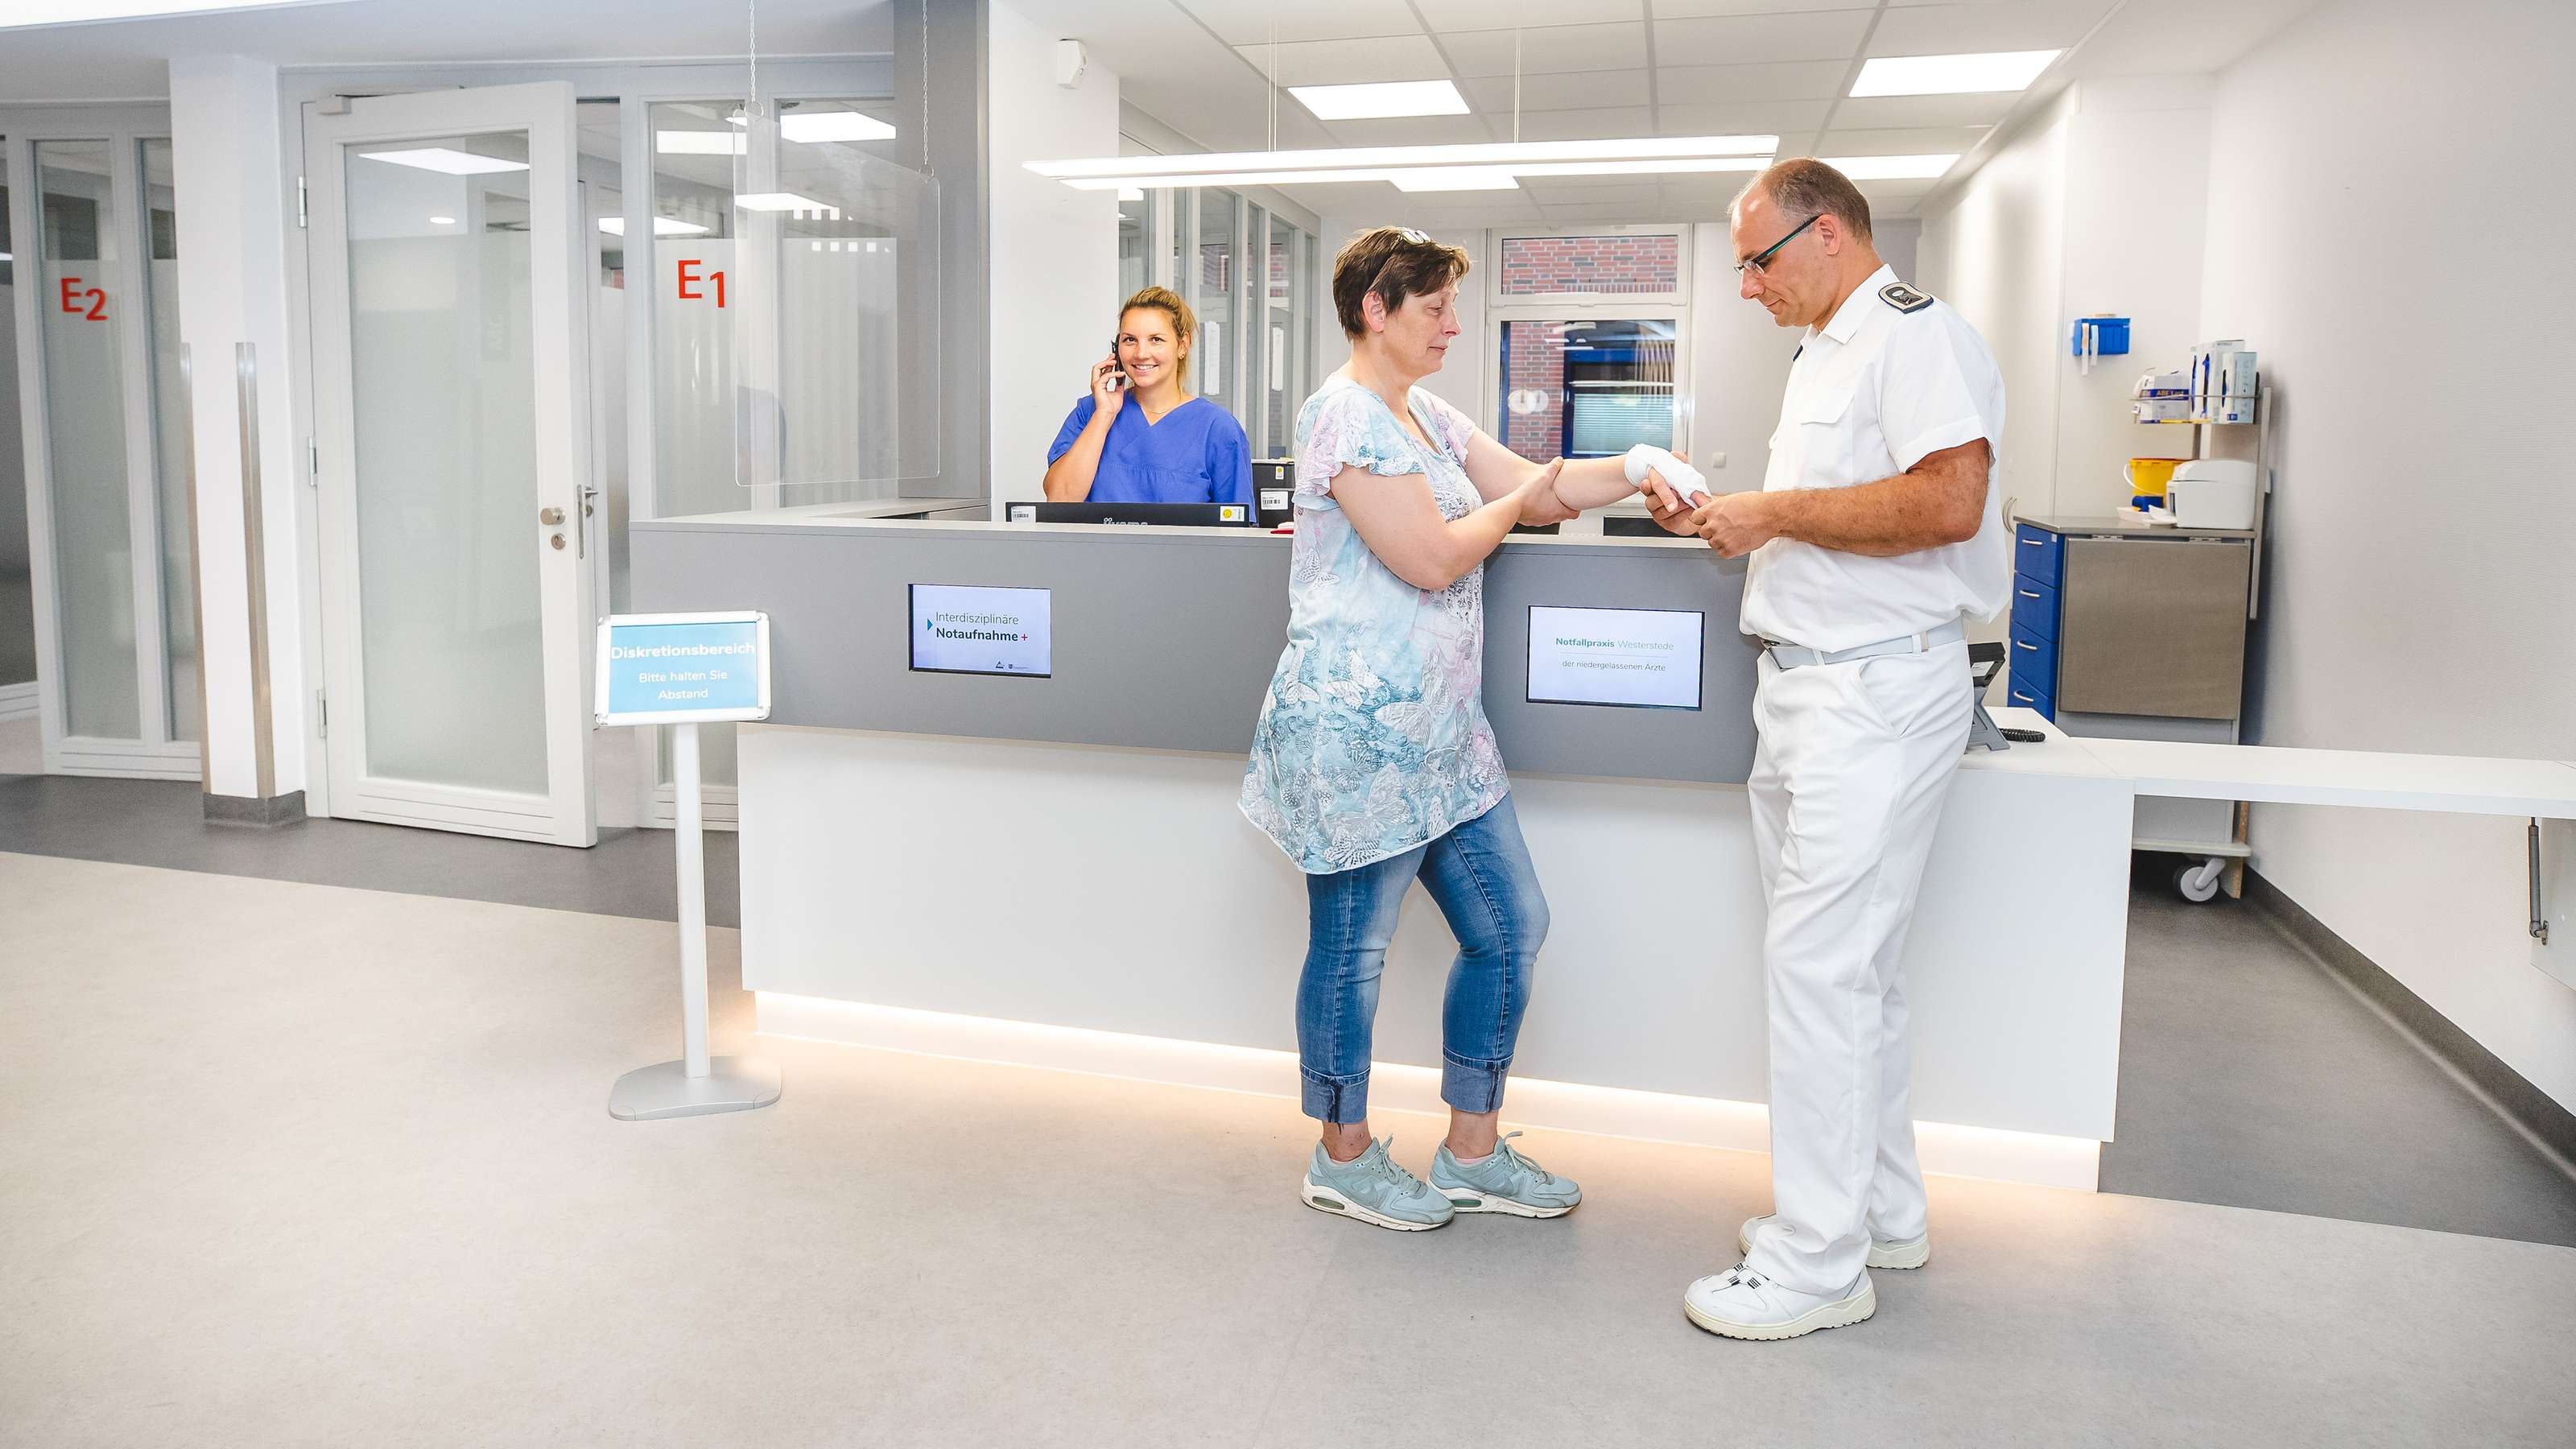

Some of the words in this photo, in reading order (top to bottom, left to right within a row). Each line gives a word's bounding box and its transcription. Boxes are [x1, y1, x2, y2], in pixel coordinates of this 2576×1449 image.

[678, 259, 724, 308] E1
[61, 278, 108, 321] E2
[935, 612, 1019, 625] Interdisziplinäre
[936, 628, 1018, 642] Notaufnahme
[611, 642, 755, 659] Diskretionsbereich
[1555, 638, 1615, 648] Notfallpraxis
[1617, 640, 1674, 650] Westerstede
[1576, 662, 1643, 671] niedergelassenen
[638, 672, 667, 683] Bitte
[670, 671, 707, 682] halten
[709, 670, 728, 680] Sie
[658, 689, 709, 700] Abstand
